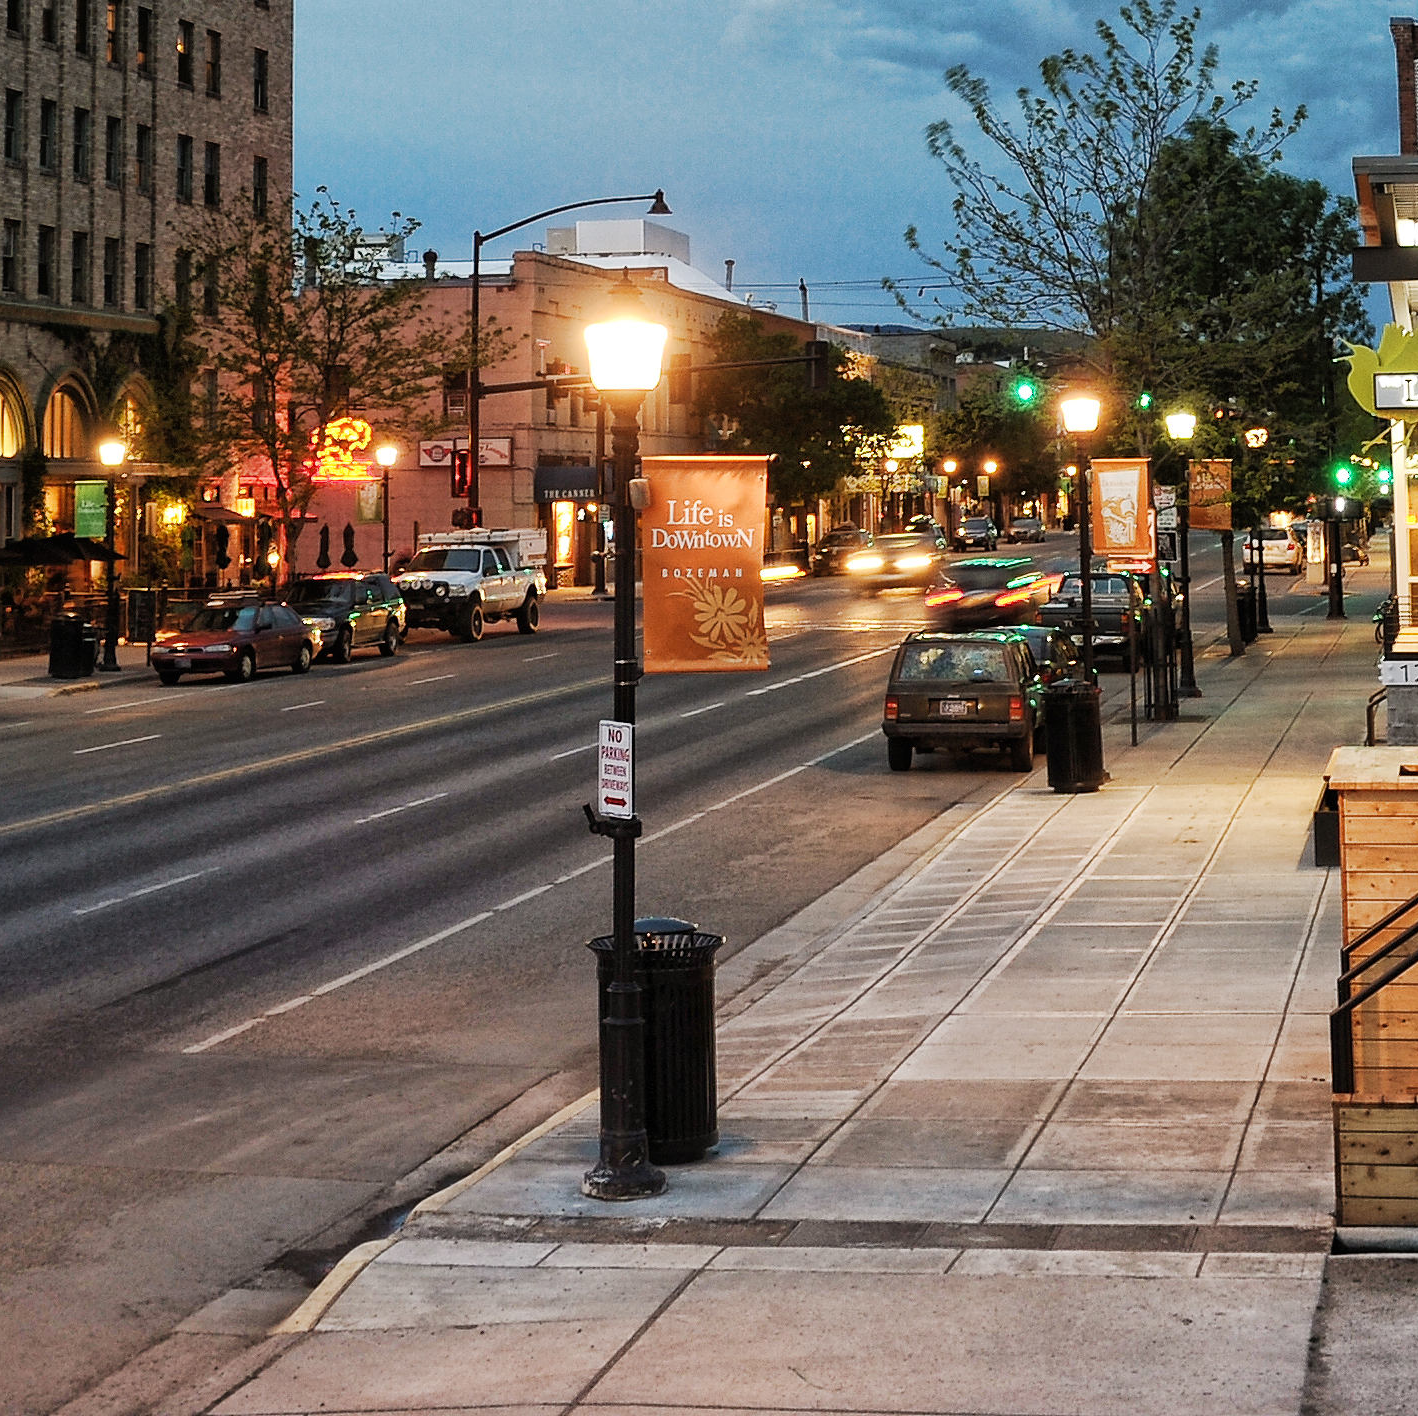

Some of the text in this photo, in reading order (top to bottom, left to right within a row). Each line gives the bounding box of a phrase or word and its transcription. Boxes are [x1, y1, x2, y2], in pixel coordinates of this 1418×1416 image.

[666, 499, 734, 528] Life is
[661, 568, 743, 578] BOZEMAN
[608, 728, 623, 744] NO
[601, 745, 630, 763] PARKING
